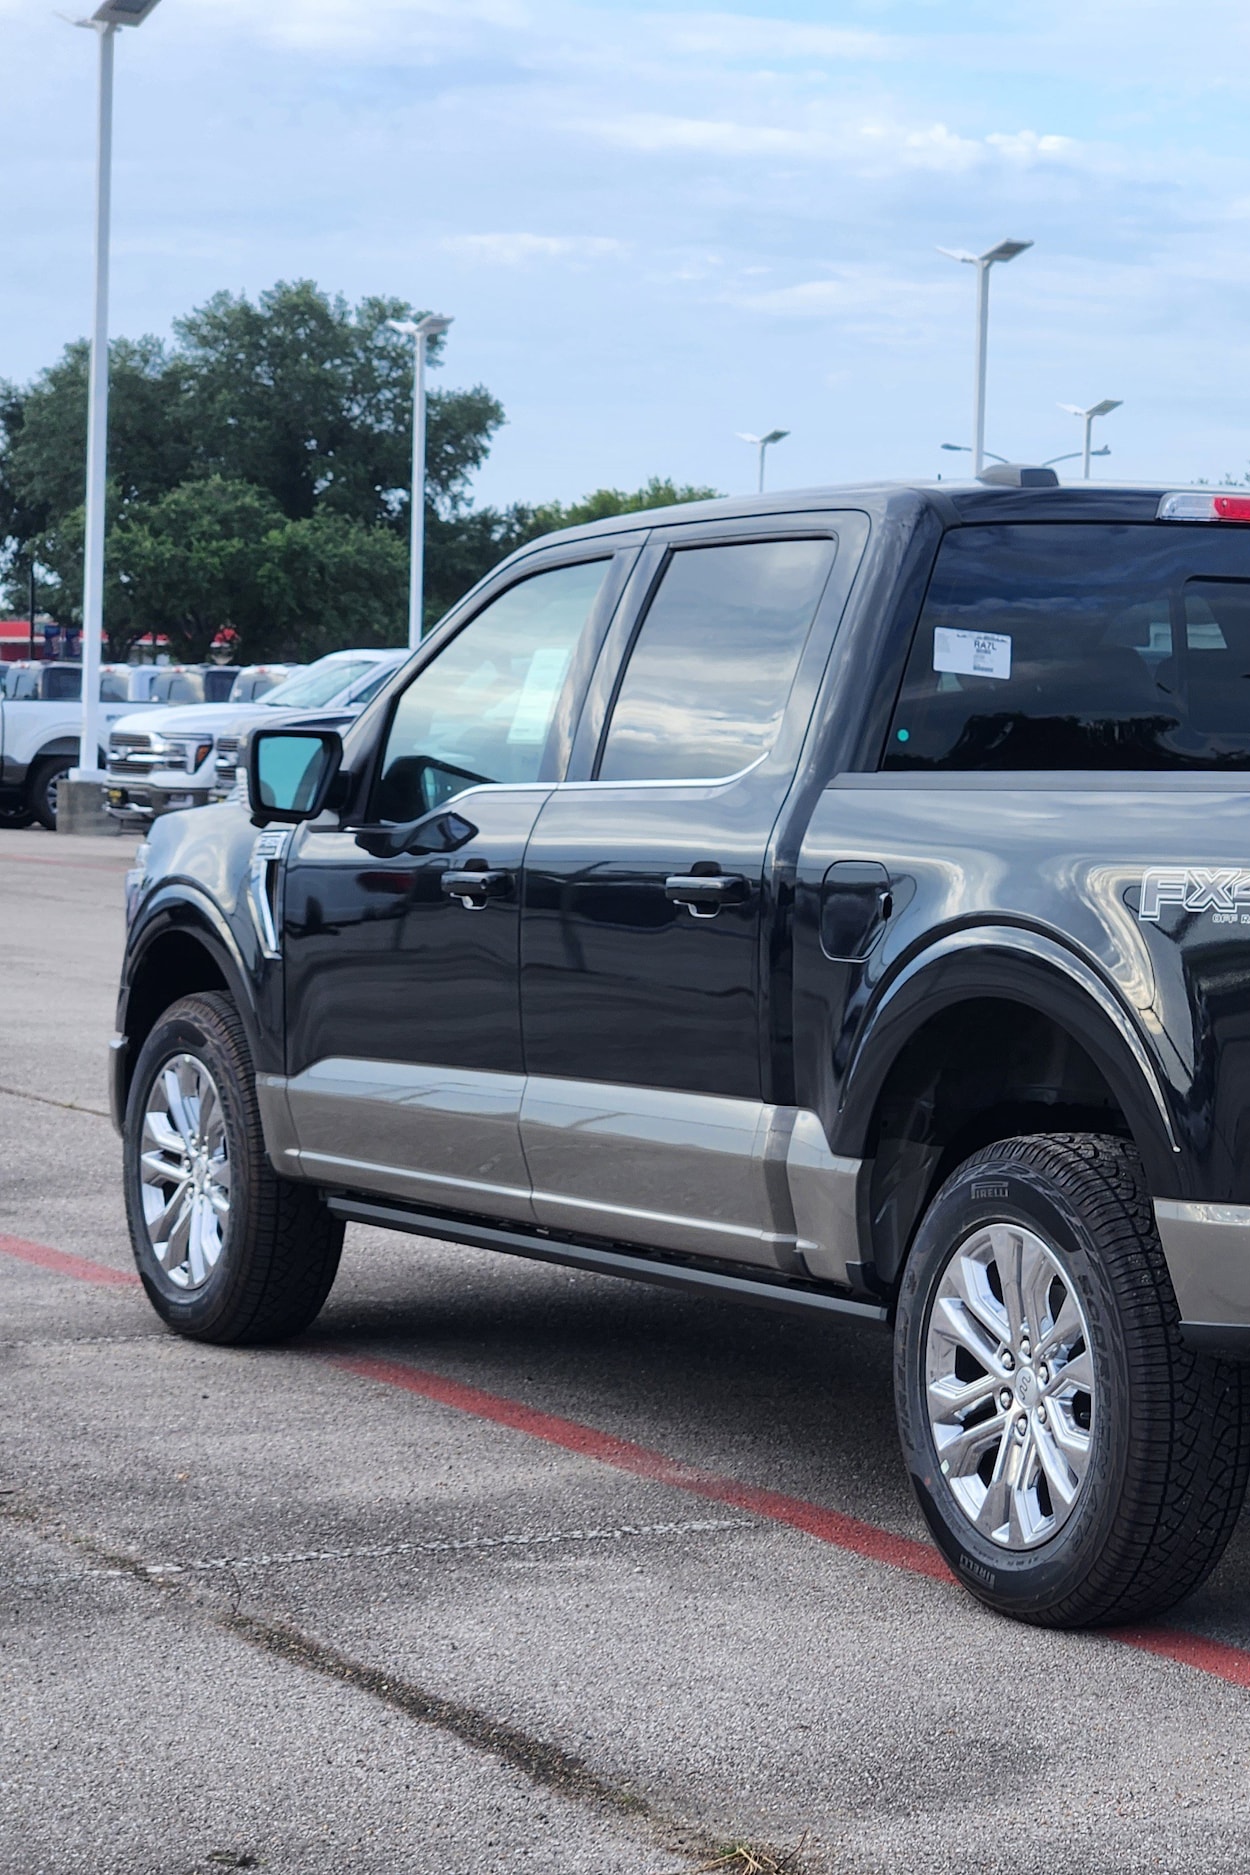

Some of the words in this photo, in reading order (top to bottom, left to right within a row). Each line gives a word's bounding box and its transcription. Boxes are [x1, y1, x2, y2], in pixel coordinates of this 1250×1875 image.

[974, 640, 997, 650] RA7L
[1212, 914, 1238, 923] OFF
[971, 1181, 1009, 1199] PIRELLI
[959, 1553, 996, 1590] PIRELLI
